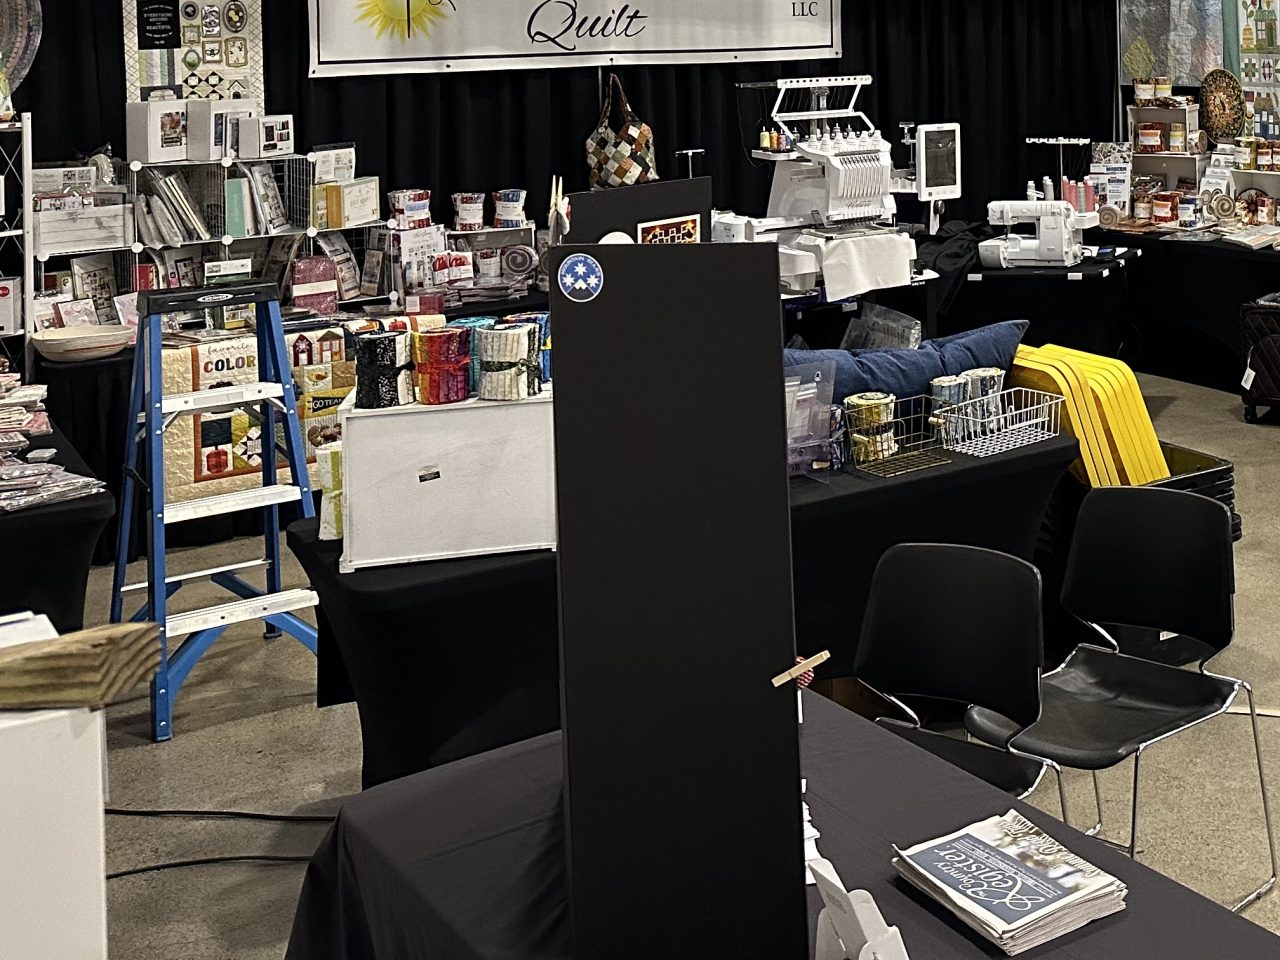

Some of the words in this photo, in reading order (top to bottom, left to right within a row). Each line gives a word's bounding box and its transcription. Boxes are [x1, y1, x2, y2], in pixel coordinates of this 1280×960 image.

[791, 1, 819, 18] LLC
[207, 342, 253, 356] favorite
[204, 355, 256, 373] COLOR
[313, 399, 323, 408] GO
[932, 860, 981, 896] Country
